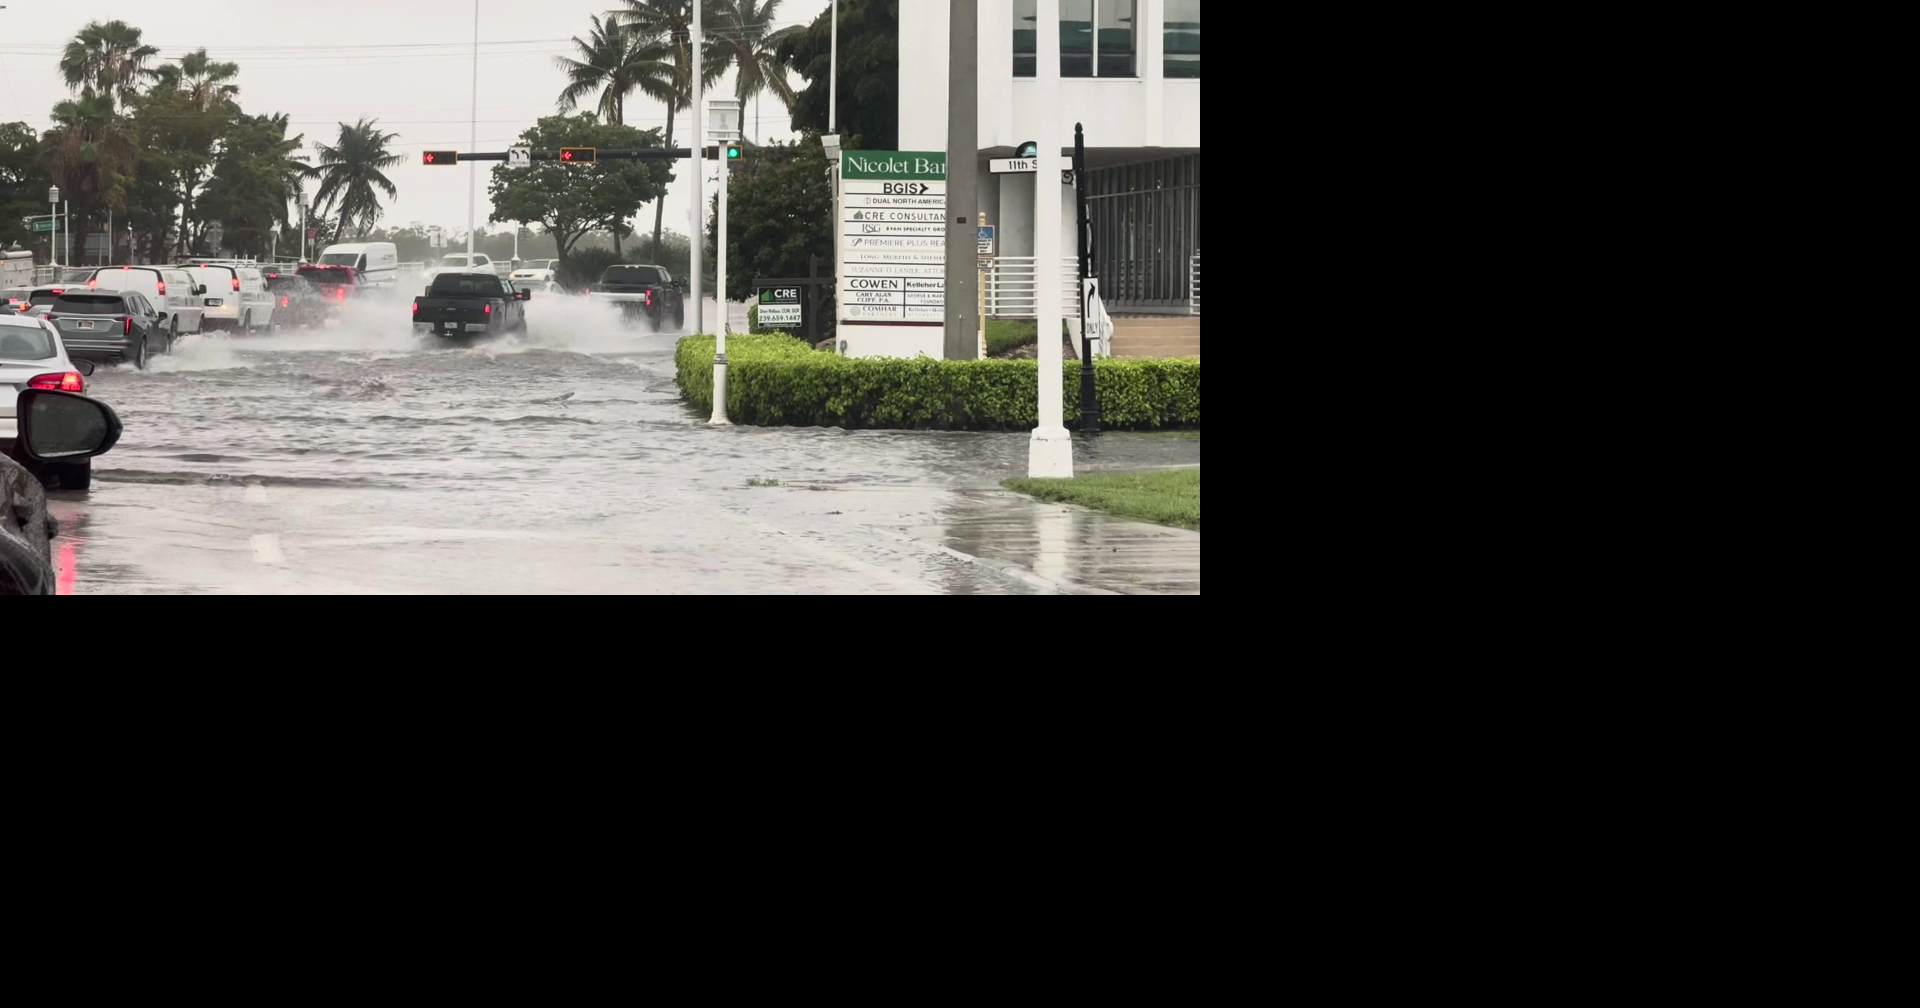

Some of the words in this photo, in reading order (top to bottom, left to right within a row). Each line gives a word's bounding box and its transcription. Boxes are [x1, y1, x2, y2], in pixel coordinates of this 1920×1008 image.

[847, 156, 909, 174] Nicolet
[1009, 160, 1028, 170] 11th
[884, 183, 918, 194] BGIS
[864, 212, 884, 220] CRE
[890, 212, 946, 220] CONSULTAN
[862, 224, 880, 232] RSG
[850, 279, 898, 288] COWEN
[774, 289, 797, 298] CRE
[1087, 323, 1098, 334] ONLY
